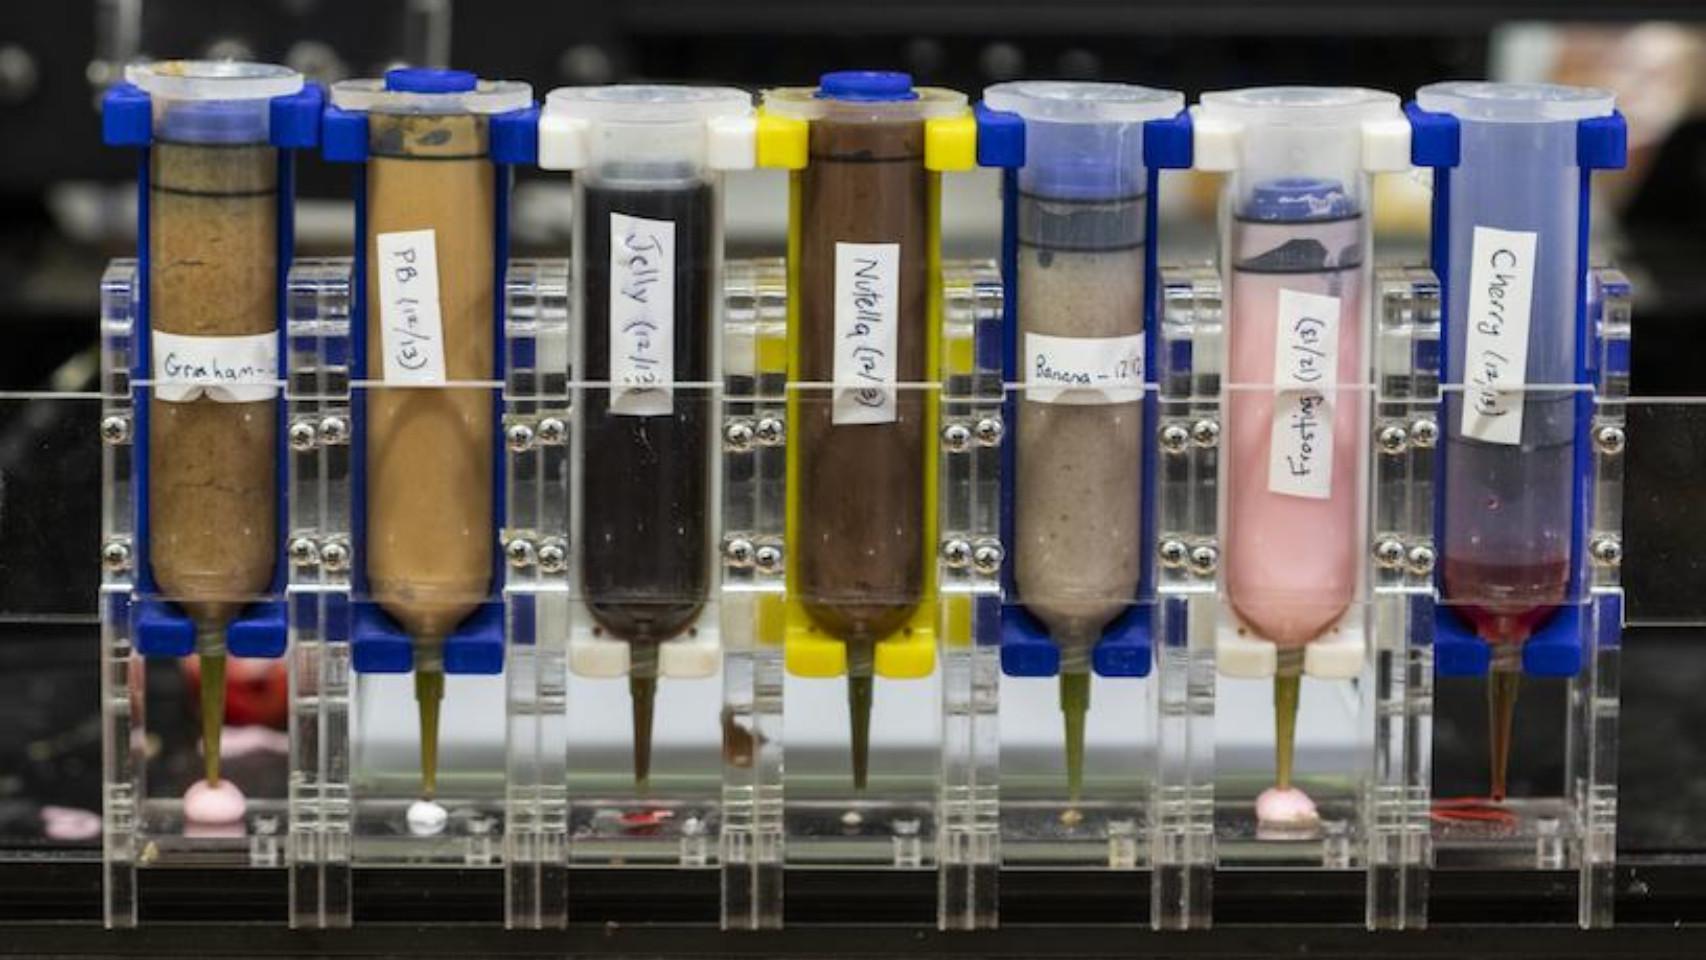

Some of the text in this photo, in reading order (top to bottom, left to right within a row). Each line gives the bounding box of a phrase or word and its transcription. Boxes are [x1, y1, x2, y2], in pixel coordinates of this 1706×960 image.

[392, 248, 431, 370] PB (12/13)
[621, 234, 664, 303] Jelly
[1477, 249, 1517, 336] Cherry
[845, 258, 886, 408] Nutella (12/3)
[1036, 354, 1091, 384] Banana
[1287, 316, 1326, 477] Frosting (12/13)
